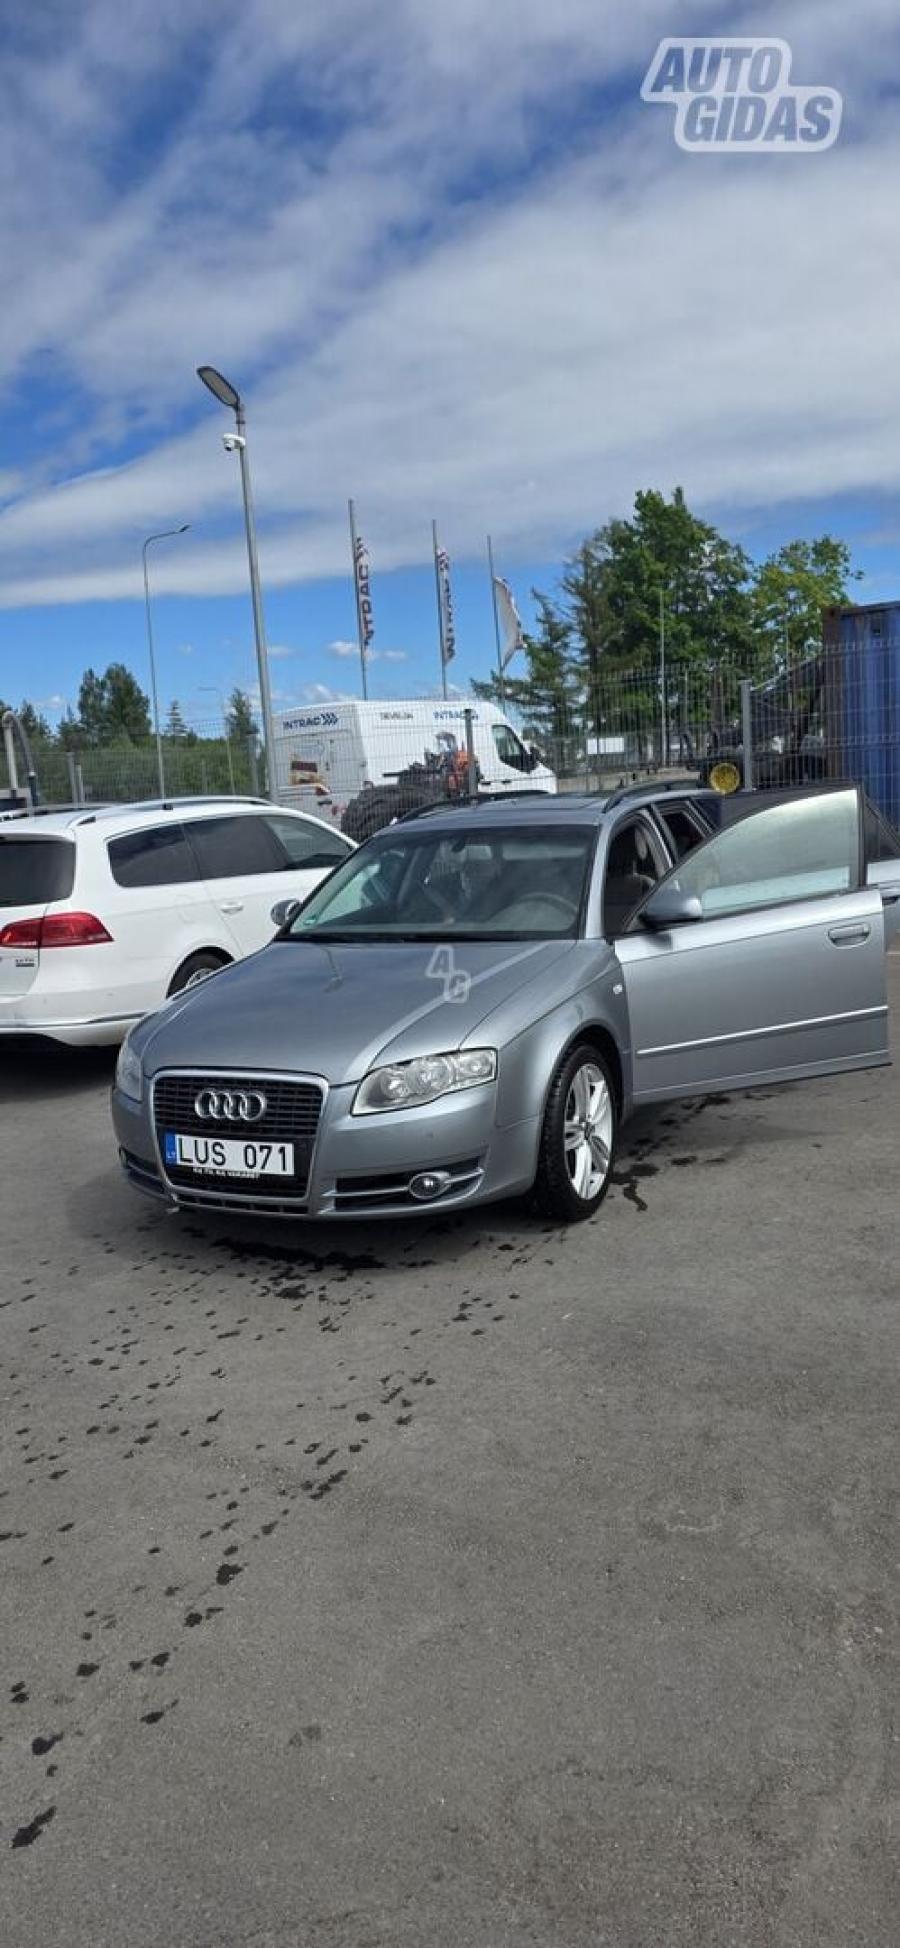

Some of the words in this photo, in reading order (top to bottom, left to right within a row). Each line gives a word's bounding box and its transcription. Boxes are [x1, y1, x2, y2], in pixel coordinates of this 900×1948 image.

[283, 716, 321, 730] INTRAC
[178, 1137, 226, 1166] LUS
[243, 1143, 287, 1172] 071
